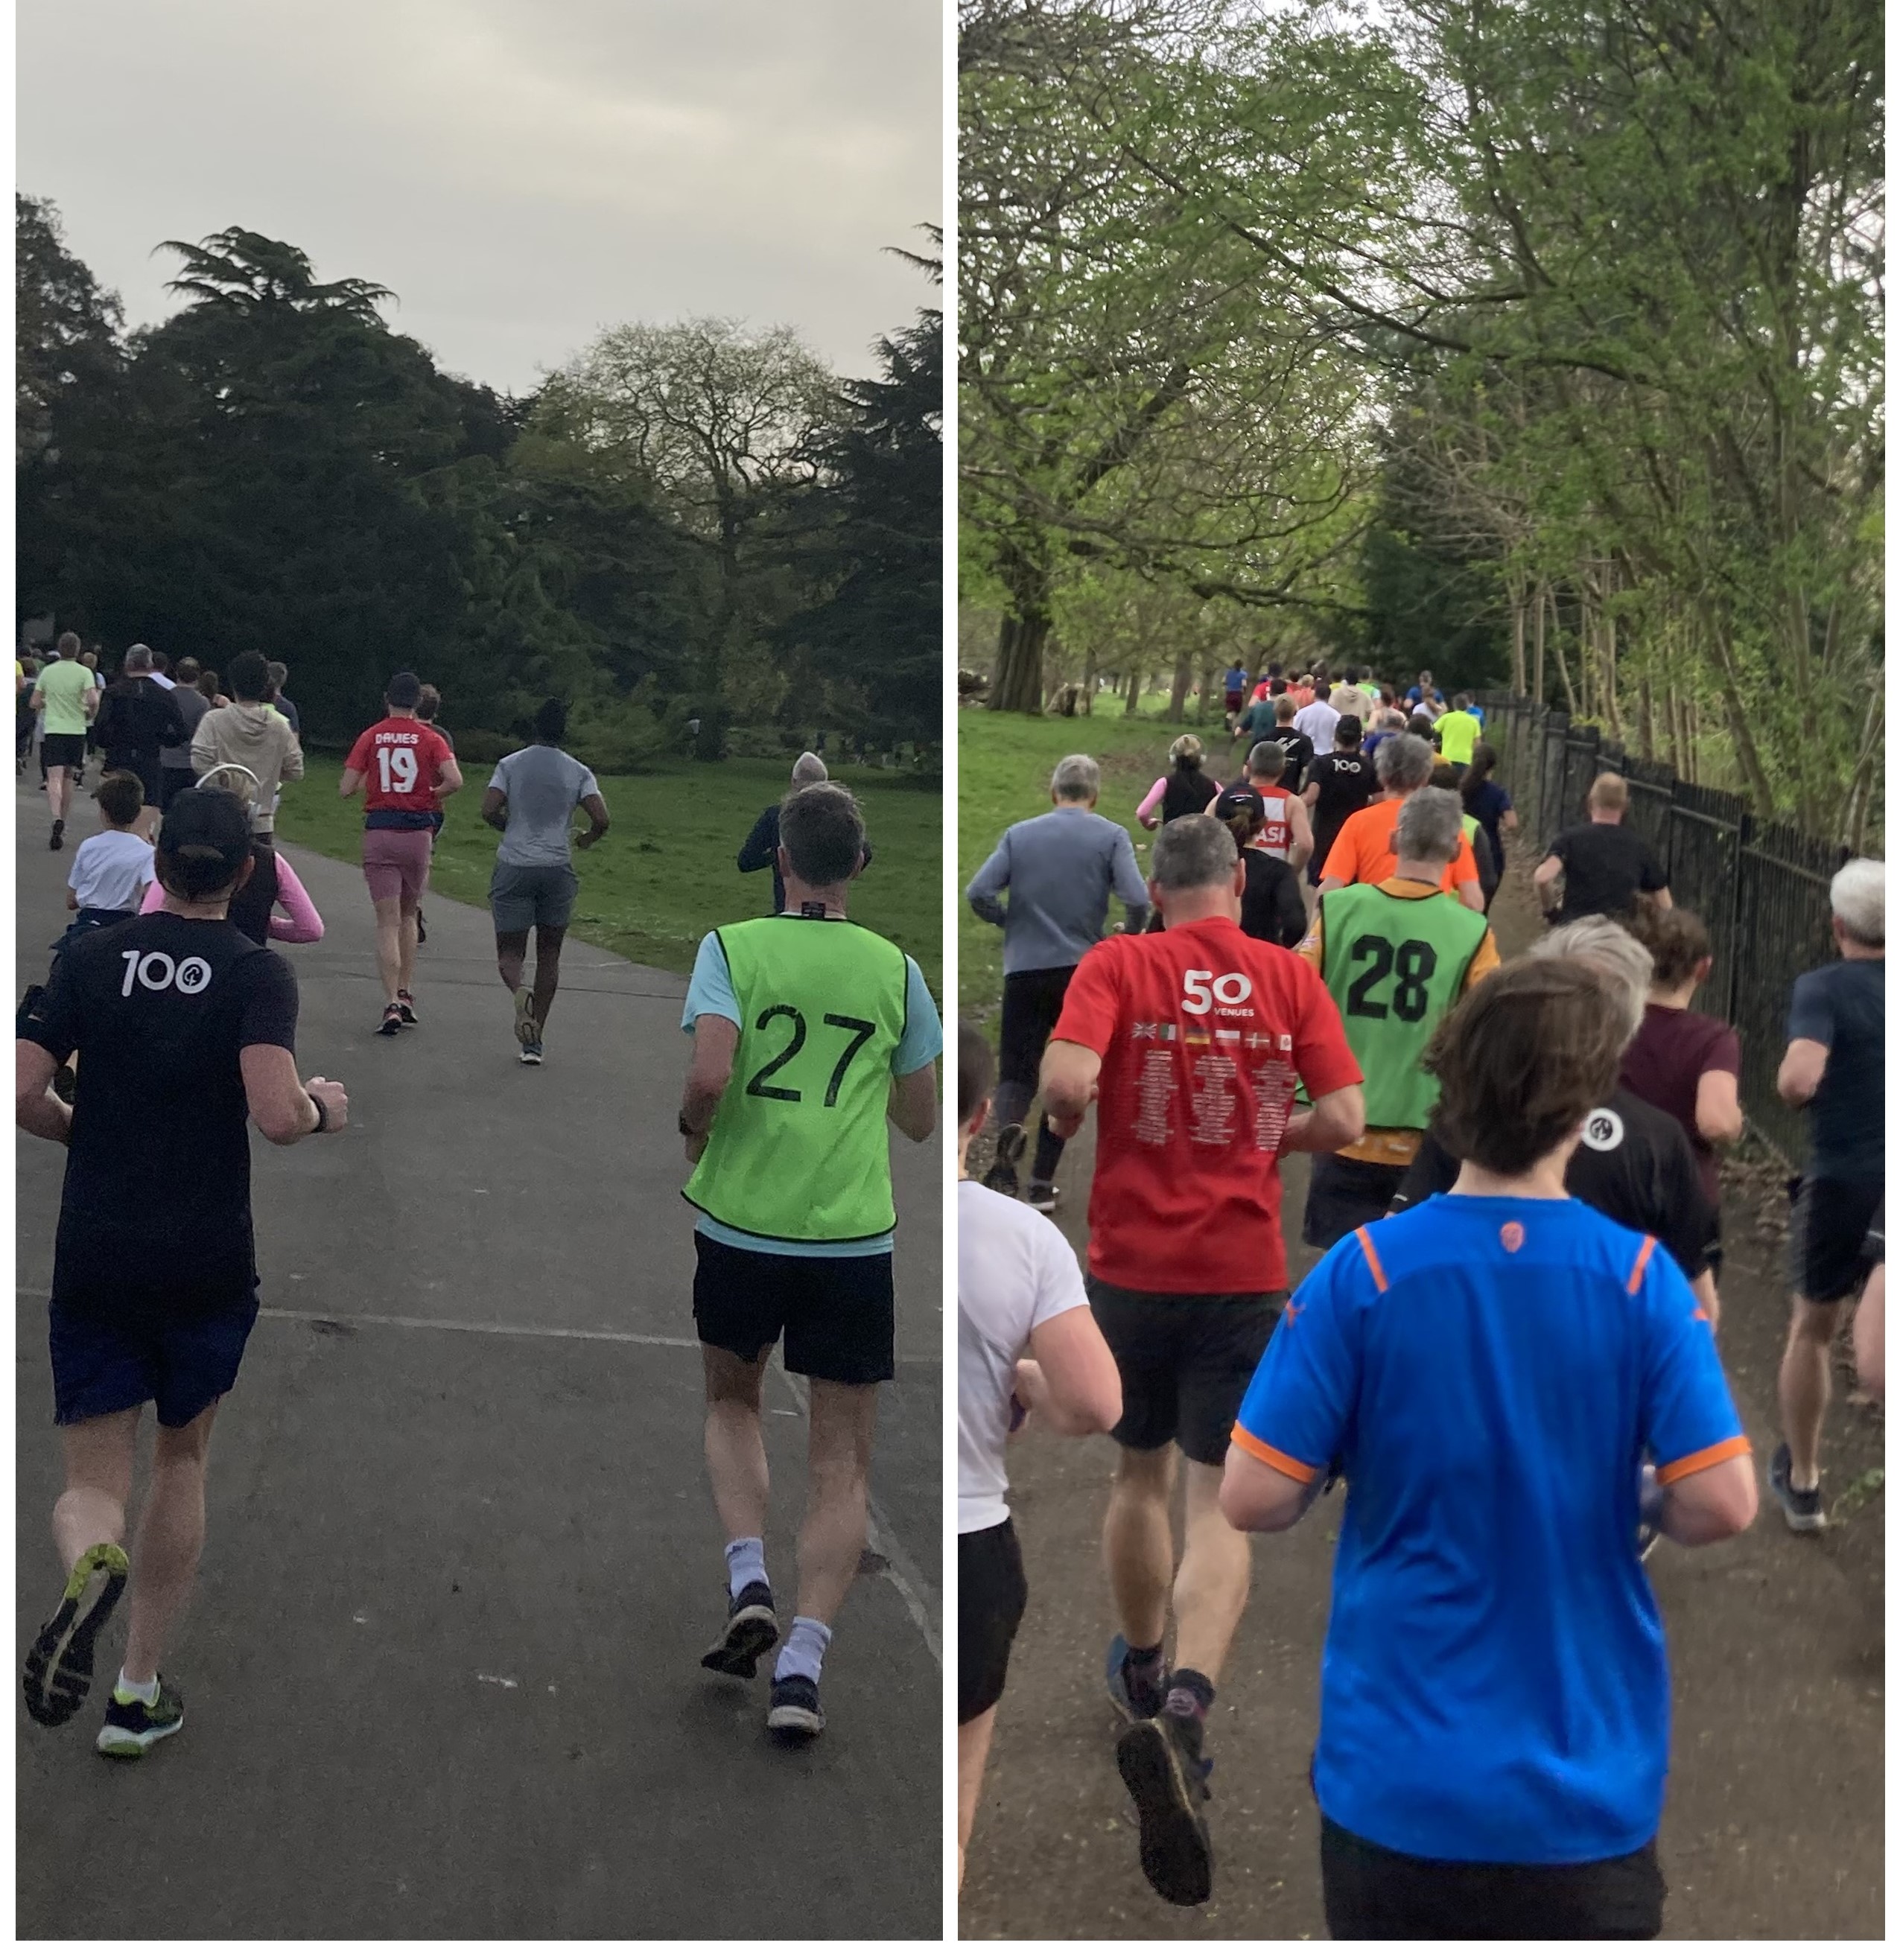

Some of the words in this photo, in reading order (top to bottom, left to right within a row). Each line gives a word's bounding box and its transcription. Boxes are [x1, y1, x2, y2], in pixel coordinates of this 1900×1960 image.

[375, 733, 419, 744] DAVIES
[376, 748, 418, 792] 19
[1332, 759, 1362, 773] 100
[121, 950, 212, 997] 100
[1181, 970, 1252, 1014] 50
[1347, 935, 1437, 1022] 28
[1214, 1008, 1254, 1016] VENUES
[746, 1005, 876, 1108] 27
